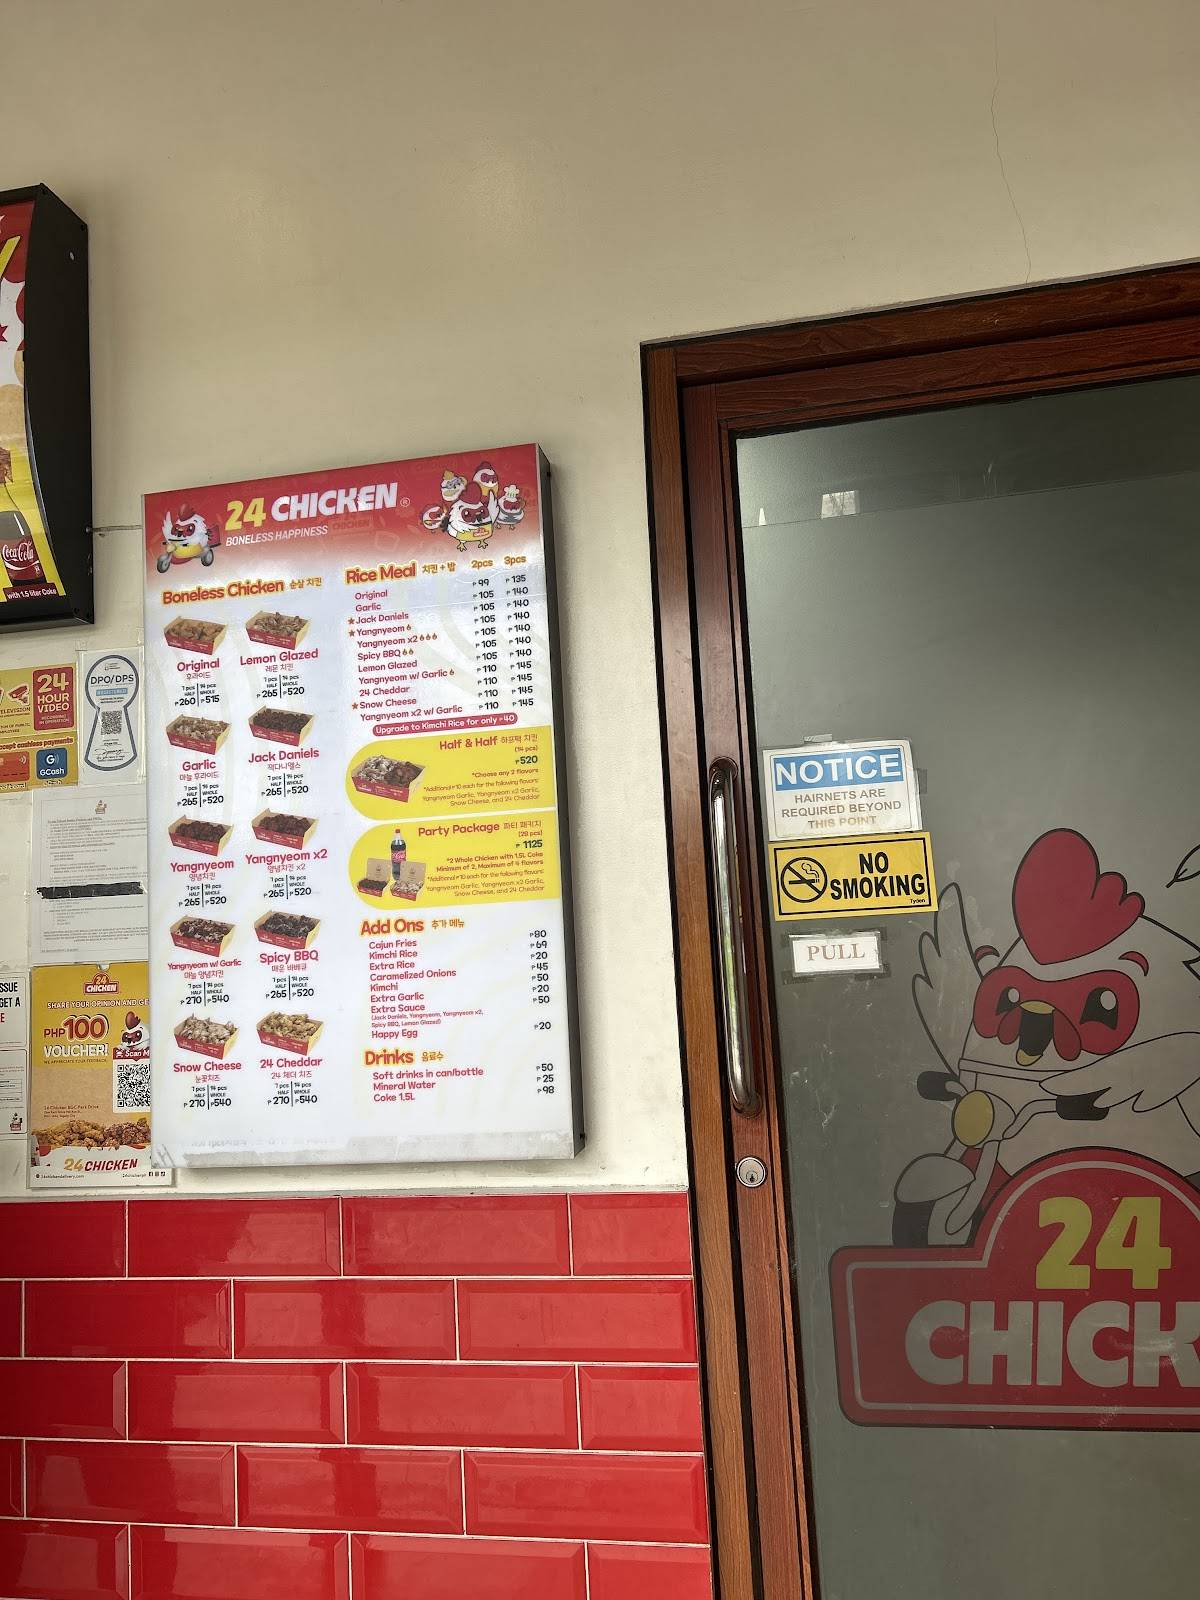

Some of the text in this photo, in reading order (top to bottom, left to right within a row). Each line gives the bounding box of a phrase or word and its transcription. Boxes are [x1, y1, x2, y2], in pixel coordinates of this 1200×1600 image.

[225, 482, 398, 530] 24 CHICKEN
[226, 526, 328, 546] BONELESS HAPPINESS
[472, 555, 526, 569] 2pcs 3pcs
[346, 562, 417, 583] Rice Meal
[163, 580, 284, 604] Boneless Chicken
[355, 590, 387, 600] Original
[356, 603, 381, 612] Garlic
[356, 612, 408, 624] Jack Daniels
[356, 626, 404, 636] Yangnyeom
[357, 635, 417, 648] Yangnyeom x2
[240, 648, 318, 666] Lemon Glazed
[358, 650, 400, 661] Spicy BBQ
[177, 658, 219, 672] Original
[358, 660, 417, 672] Lemon Glazed
[37, 673, 69, 693] 24
[91, 674, 134, 684] DPO/DPS
[359, 673, 407, 685] Yangnyeom
[422, 669, 447, 678] Garlic
[373, 686, 410, 696] Cheddar
[38, 693, 69, 704] HOUR
[360, 698, 416, 709] Snow Cheese
[38, 703, 69, 712] VIDEO
[360, 710, 408, 721] Yangnyeom
[411, 709, 421, 717] x2
[436, 705, 462, 714] Garlic
[376, 724, 409, 734] Upgrade
[422, 721, 446, 730] Kimchi
[466, 718, 479, 727] for
[481, 716, 497, 725] only
[440, 736, 498, 750] Half & Half
[249, 748, 319, 763] Jack Daniels
[182, 759, 216, 771] Garlic
[776, 753, 901, 786] NOTICE
[40, 768, 64, 776] GCash
[794, 788, 886, 804] HAIRNETS ARE
[782, 800, 902, 818] REQUIRED BEYOND
[808, 815, 877, 829] THIS POINT
[419, 823, 500, 837] Party Package
[245, 849, 327, 865] Yangnyeom x2
[859, 851, 889, 875] NO
[170, 860, 234, 873] Yangnyeom
[830, 873, 926, 900] SMOKING
[360, 919, 424, 935] Add Ons
[369, 939, 417, 950] Cajun Fries
[260, 950, 318, 964] Spicy BBQ
[369, 950, 418, 960] Kimchi Rice
[807, 943, 865, 962] PULL
[168, 961, 208, 971] Yangnyeom
[220, 959, 241, 967] Garlic
[370, 961, 415, 970] Extra Rice
[96, 976, 107, 984] 24
[370, 969, 456, 981] Caramelized Onions
[86, 984, 116, 992] CHICKEN
[370, 982, 398, 992] Kimchi
[15, 997, 20, 1007] A
[398, 992, 424, 1000] Garlic
[398, 1004, 425, 1012] Sauce
[372, 1029, 418, 1039] Happy Egg
[44, 1044, 108, 1058] VOUCHER!
[365, 1050, 414, 1065] Drinks
[173, 1061, 241, 1072] Snow Cheese
[260, 1057, 322, 1069] 24 Cheddar
[373, 1067, 484, 1080] Soft drinks in can/bottle
[373, 1081, 436, 1091] Mineral Water
[374, 1093, 415, 1102] Coke 1.5L
[64, 1158, 138, 1171] 24 CHICKEN
[1036, 1196, 1171, 1289] 24
